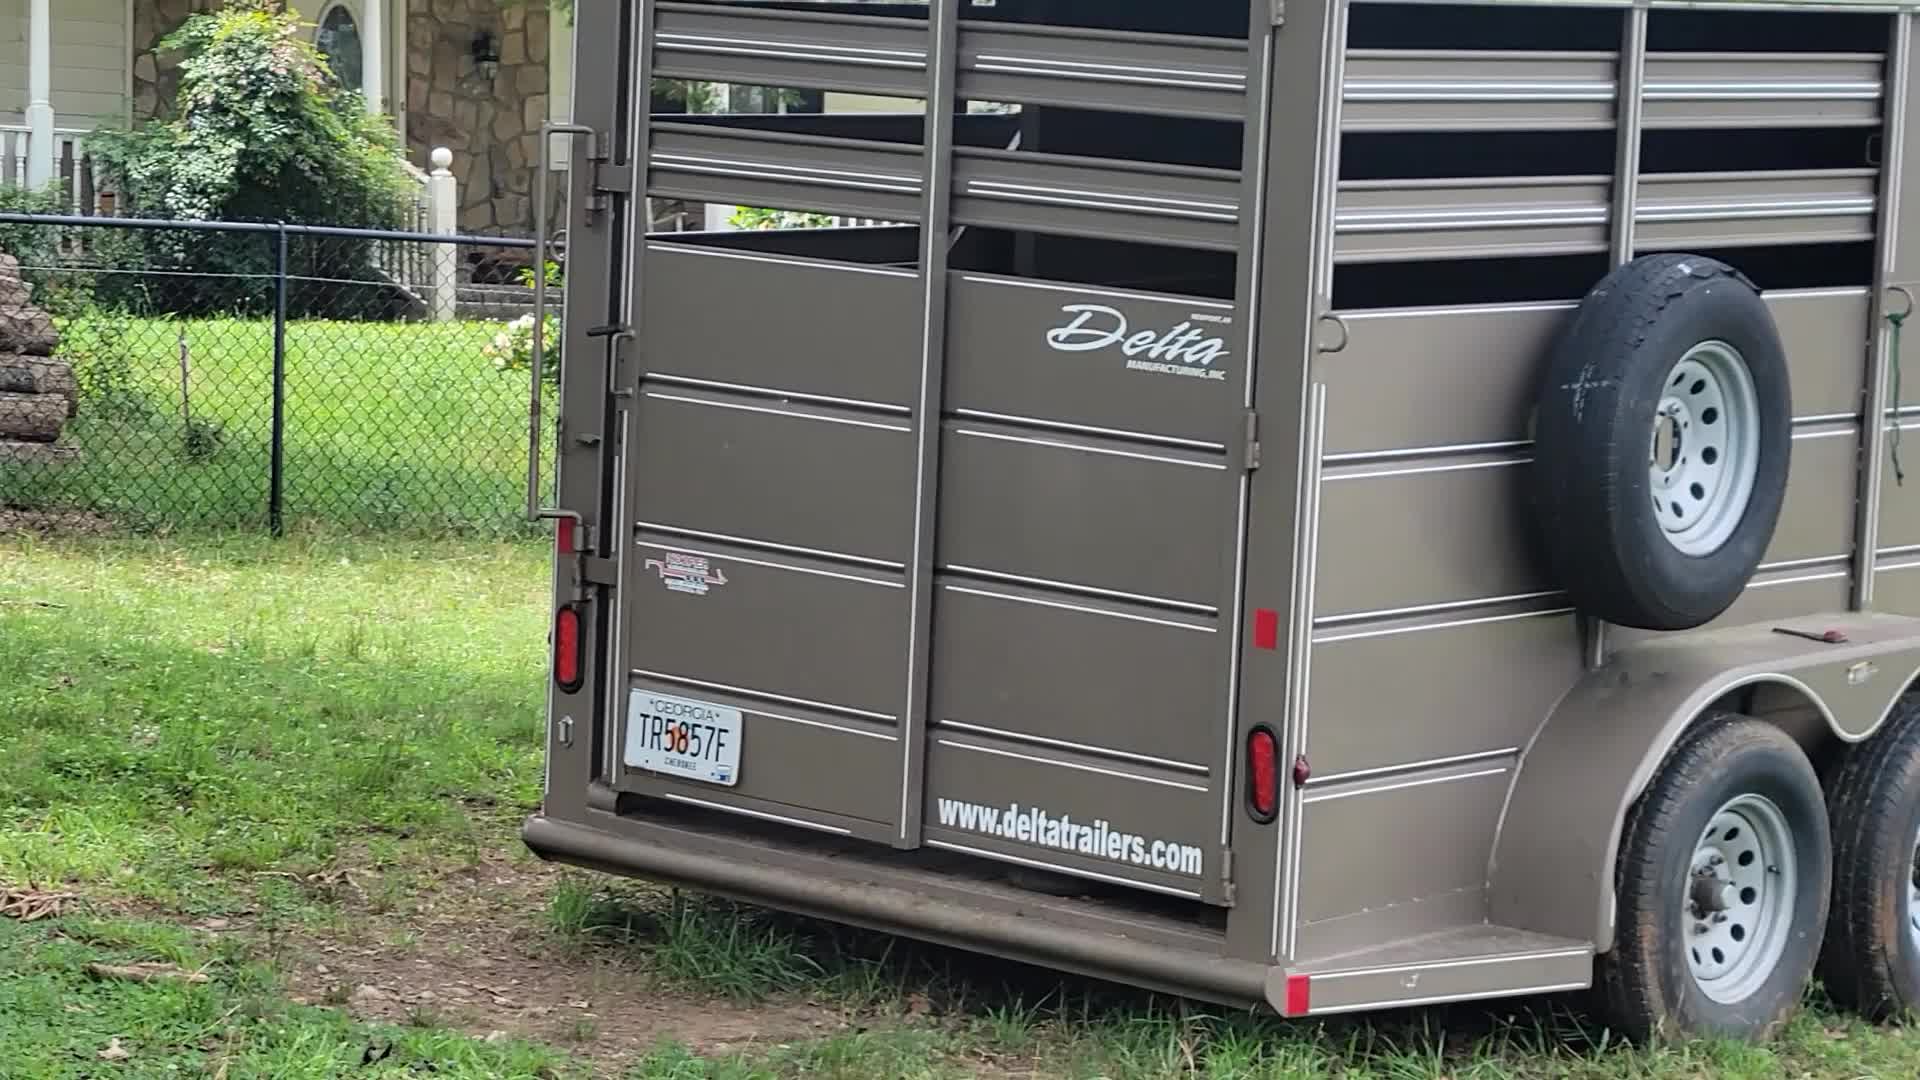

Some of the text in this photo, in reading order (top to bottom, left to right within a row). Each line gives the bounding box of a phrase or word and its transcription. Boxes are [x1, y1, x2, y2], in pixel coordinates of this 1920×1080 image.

[1046, 304, 1230, 365] Delta
[640, 713, 729, 762] TR5857F
[655, 699, 714, 722] GEORGIA
[937, 797, 1203, 876] www.deltatrailers.com
